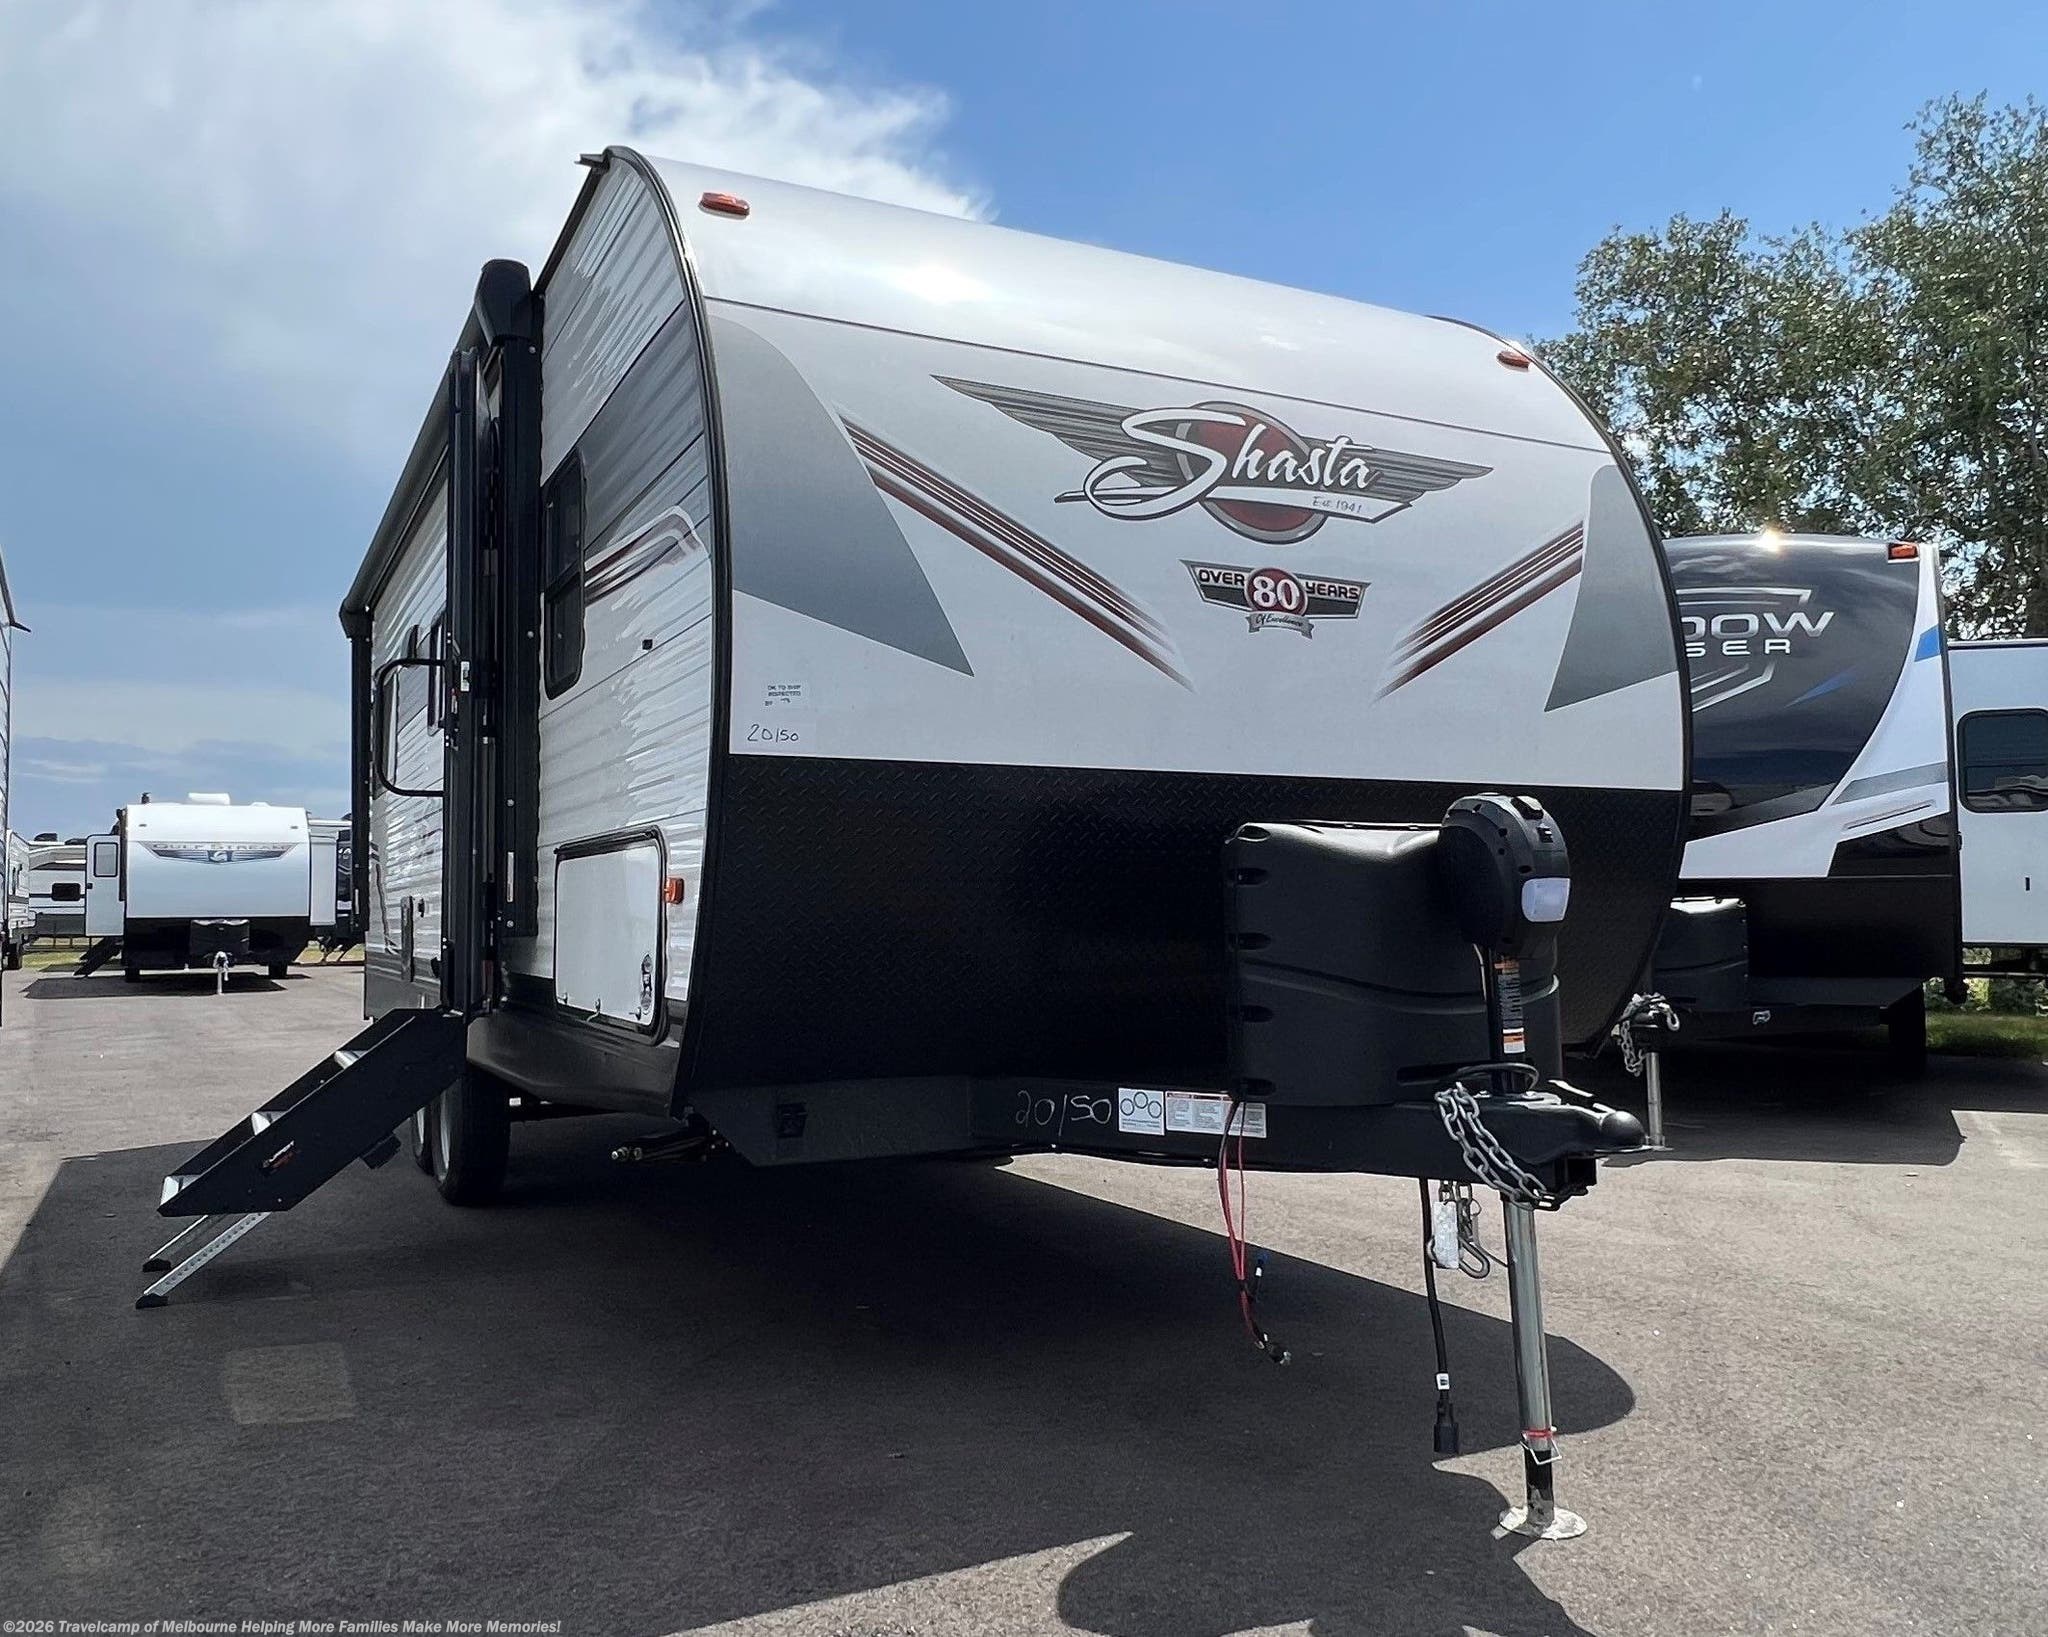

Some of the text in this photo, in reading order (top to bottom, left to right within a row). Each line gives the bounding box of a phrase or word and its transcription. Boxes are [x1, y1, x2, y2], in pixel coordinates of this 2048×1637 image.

[1084, 407, 1381, 520] Shasta
[1199, 568, 1360, 611] OVER 80 YEARS
